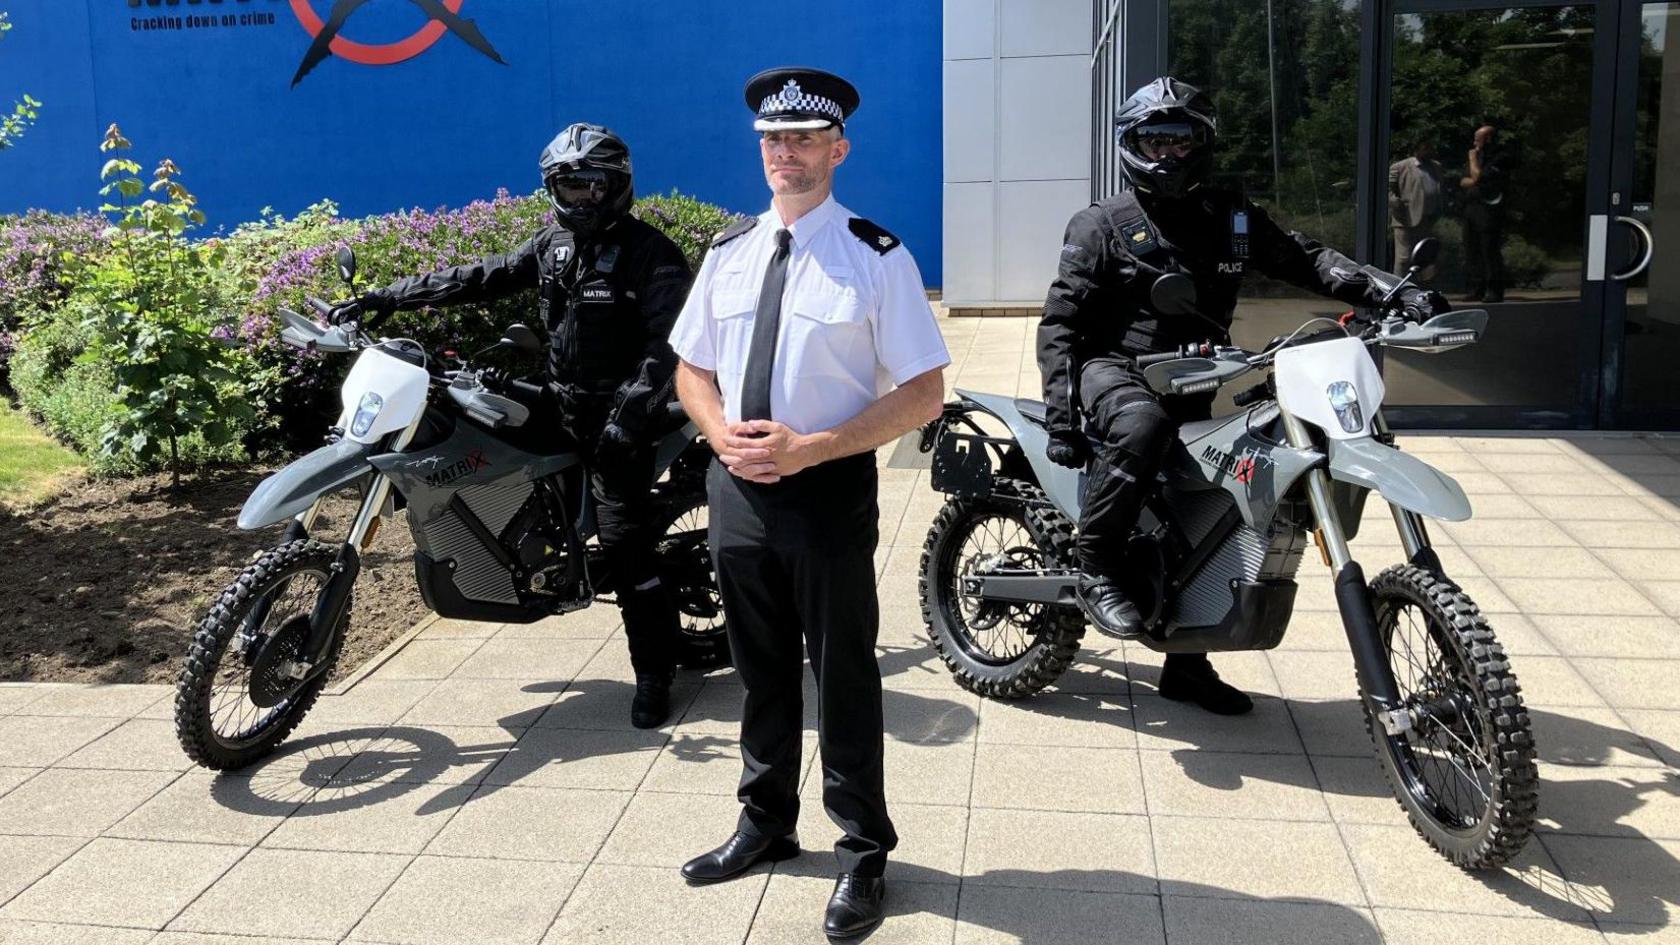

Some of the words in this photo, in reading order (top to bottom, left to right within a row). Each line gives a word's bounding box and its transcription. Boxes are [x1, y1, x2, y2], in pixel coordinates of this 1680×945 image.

[131, 16, 182, 31] Cracking
[186, 14, 218, 28] down
[222, 13, 237, 26] on
[240, 11, 275, 25] crime
[1218, 262, 1243, 273] POLICE
[583, 290, 612, 298] MATRIX
